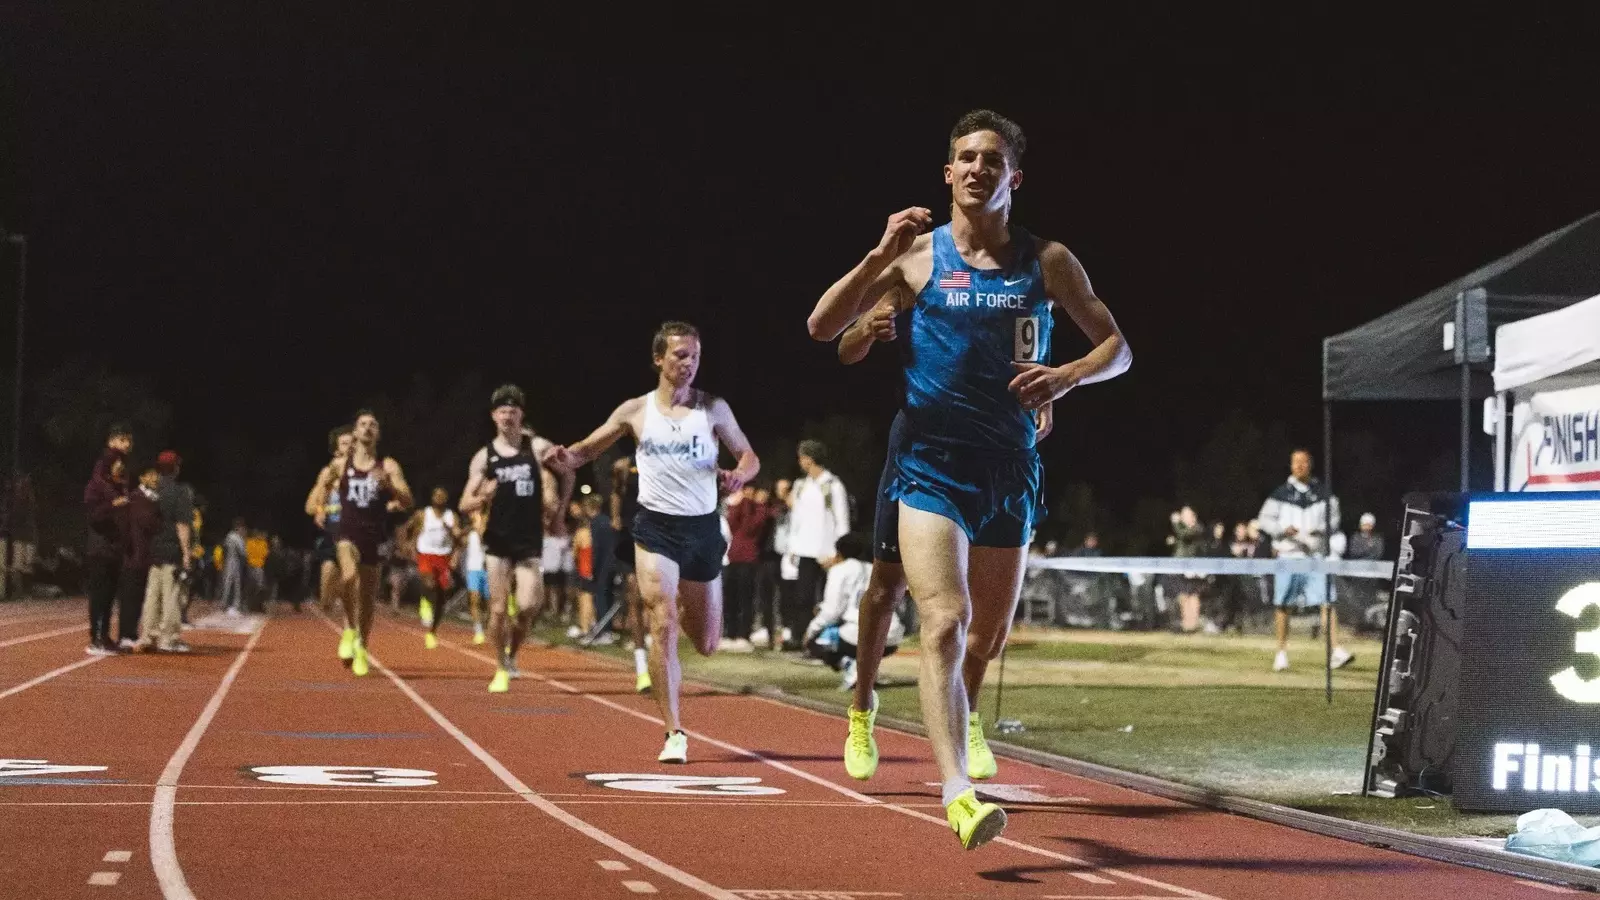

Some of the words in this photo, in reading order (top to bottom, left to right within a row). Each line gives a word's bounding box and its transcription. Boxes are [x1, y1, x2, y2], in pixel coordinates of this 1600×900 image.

[945, 292, 970, 307] AIR
[975, 293, 1028, 310] FORCE
[1021, 319, 1036, 360] 9
[250, 765, 439, 787] 3
[584, 772, 787, 796] 2
